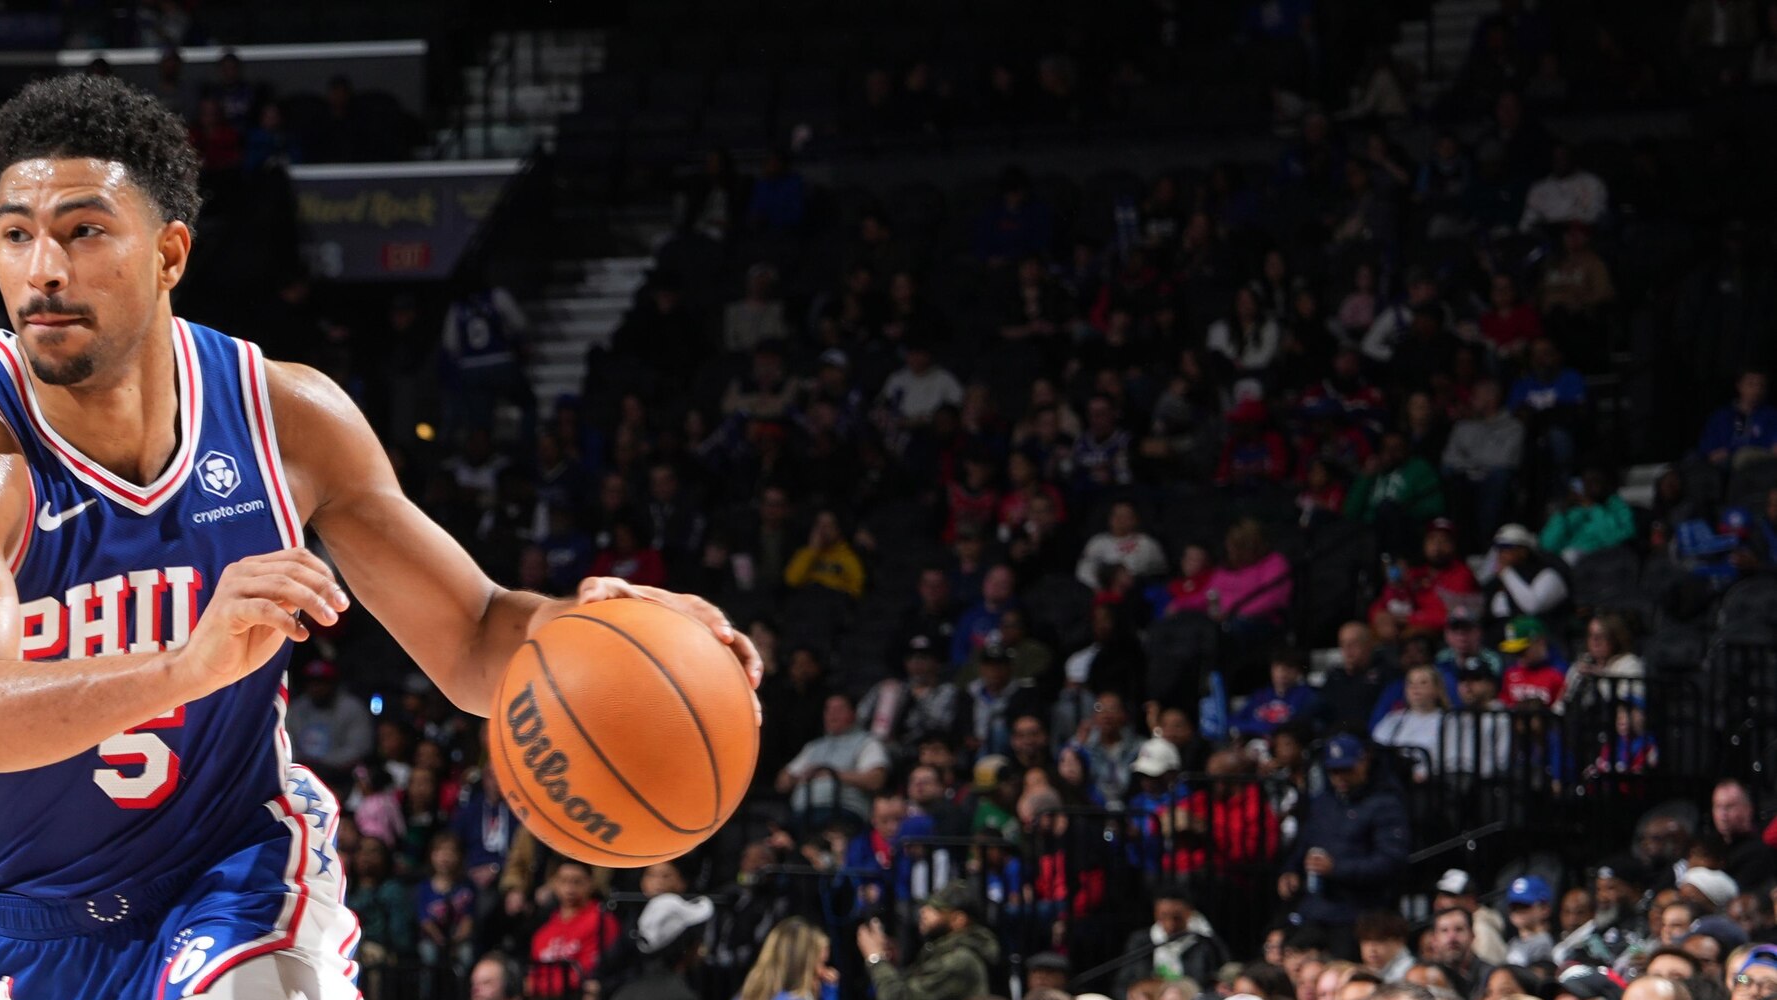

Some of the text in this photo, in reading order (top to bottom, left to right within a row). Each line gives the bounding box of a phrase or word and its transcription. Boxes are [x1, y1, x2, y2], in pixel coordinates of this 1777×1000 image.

[191, 499, 265, 524] crypto.com
[93, 704, 187, 810] 5
[506, 680, 623, 845] Wilson
